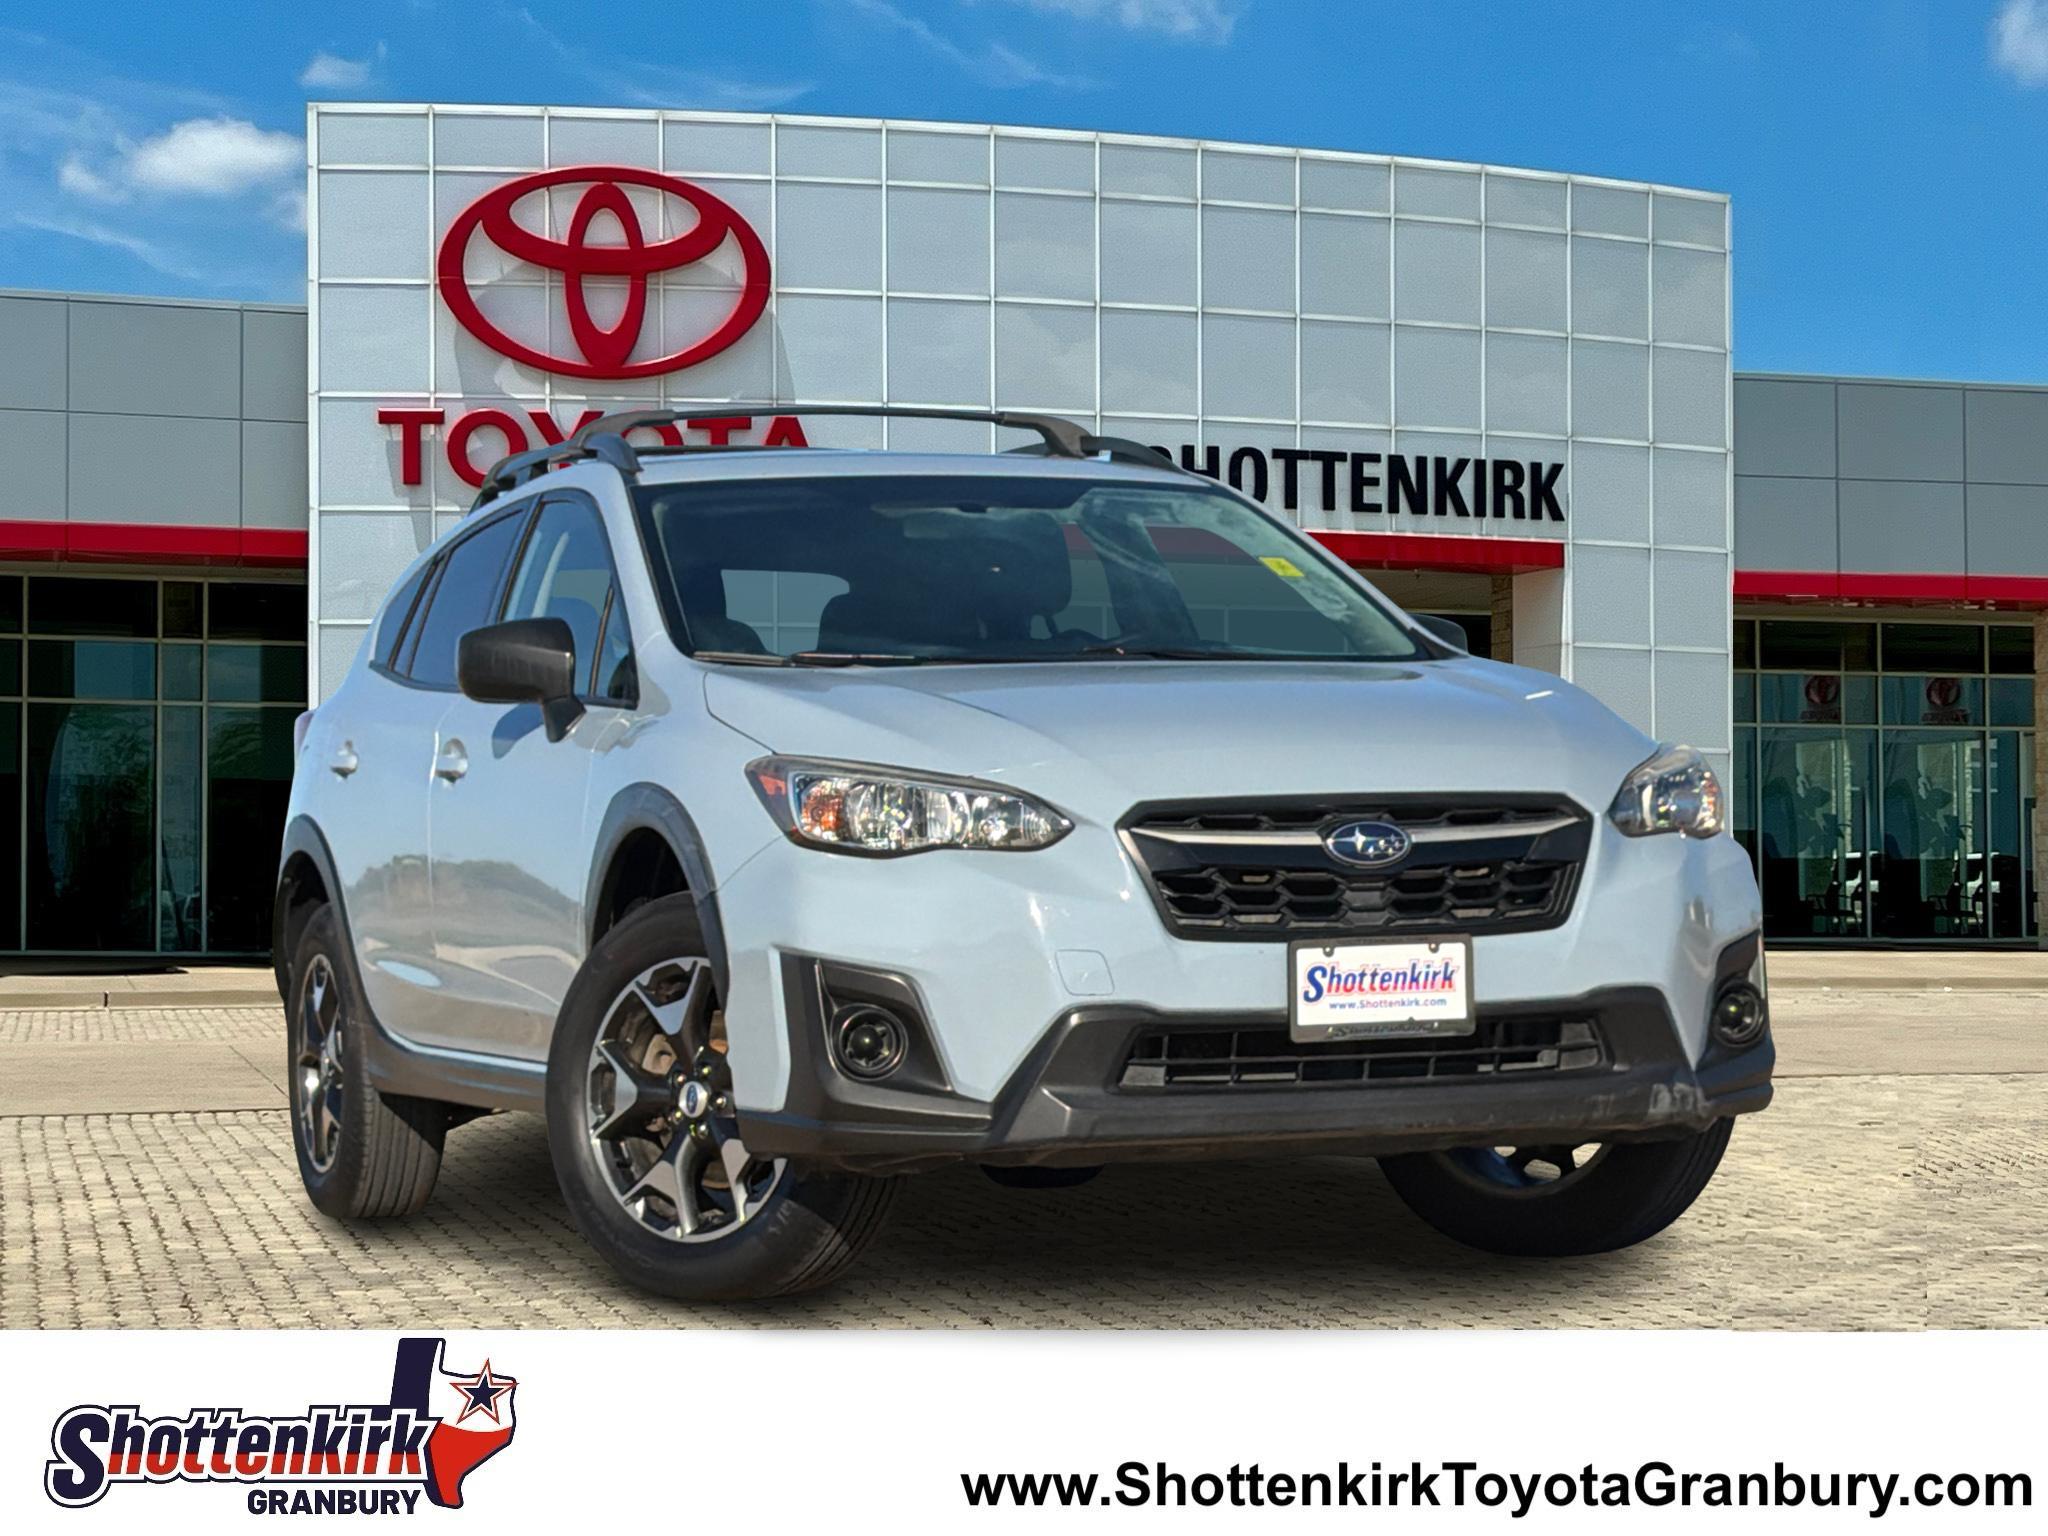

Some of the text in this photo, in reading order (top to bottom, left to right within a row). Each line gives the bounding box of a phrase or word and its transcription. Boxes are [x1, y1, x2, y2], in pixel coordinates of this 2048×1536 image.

[378, 407, 809, 489] TOYT
[1149, 443, 1565, 522] HOTTENKIRK
[1303, 959, 1456, 1003] Shottenkirk
[1328, 997, 1448, 1010] www.Shottenkirk.com
